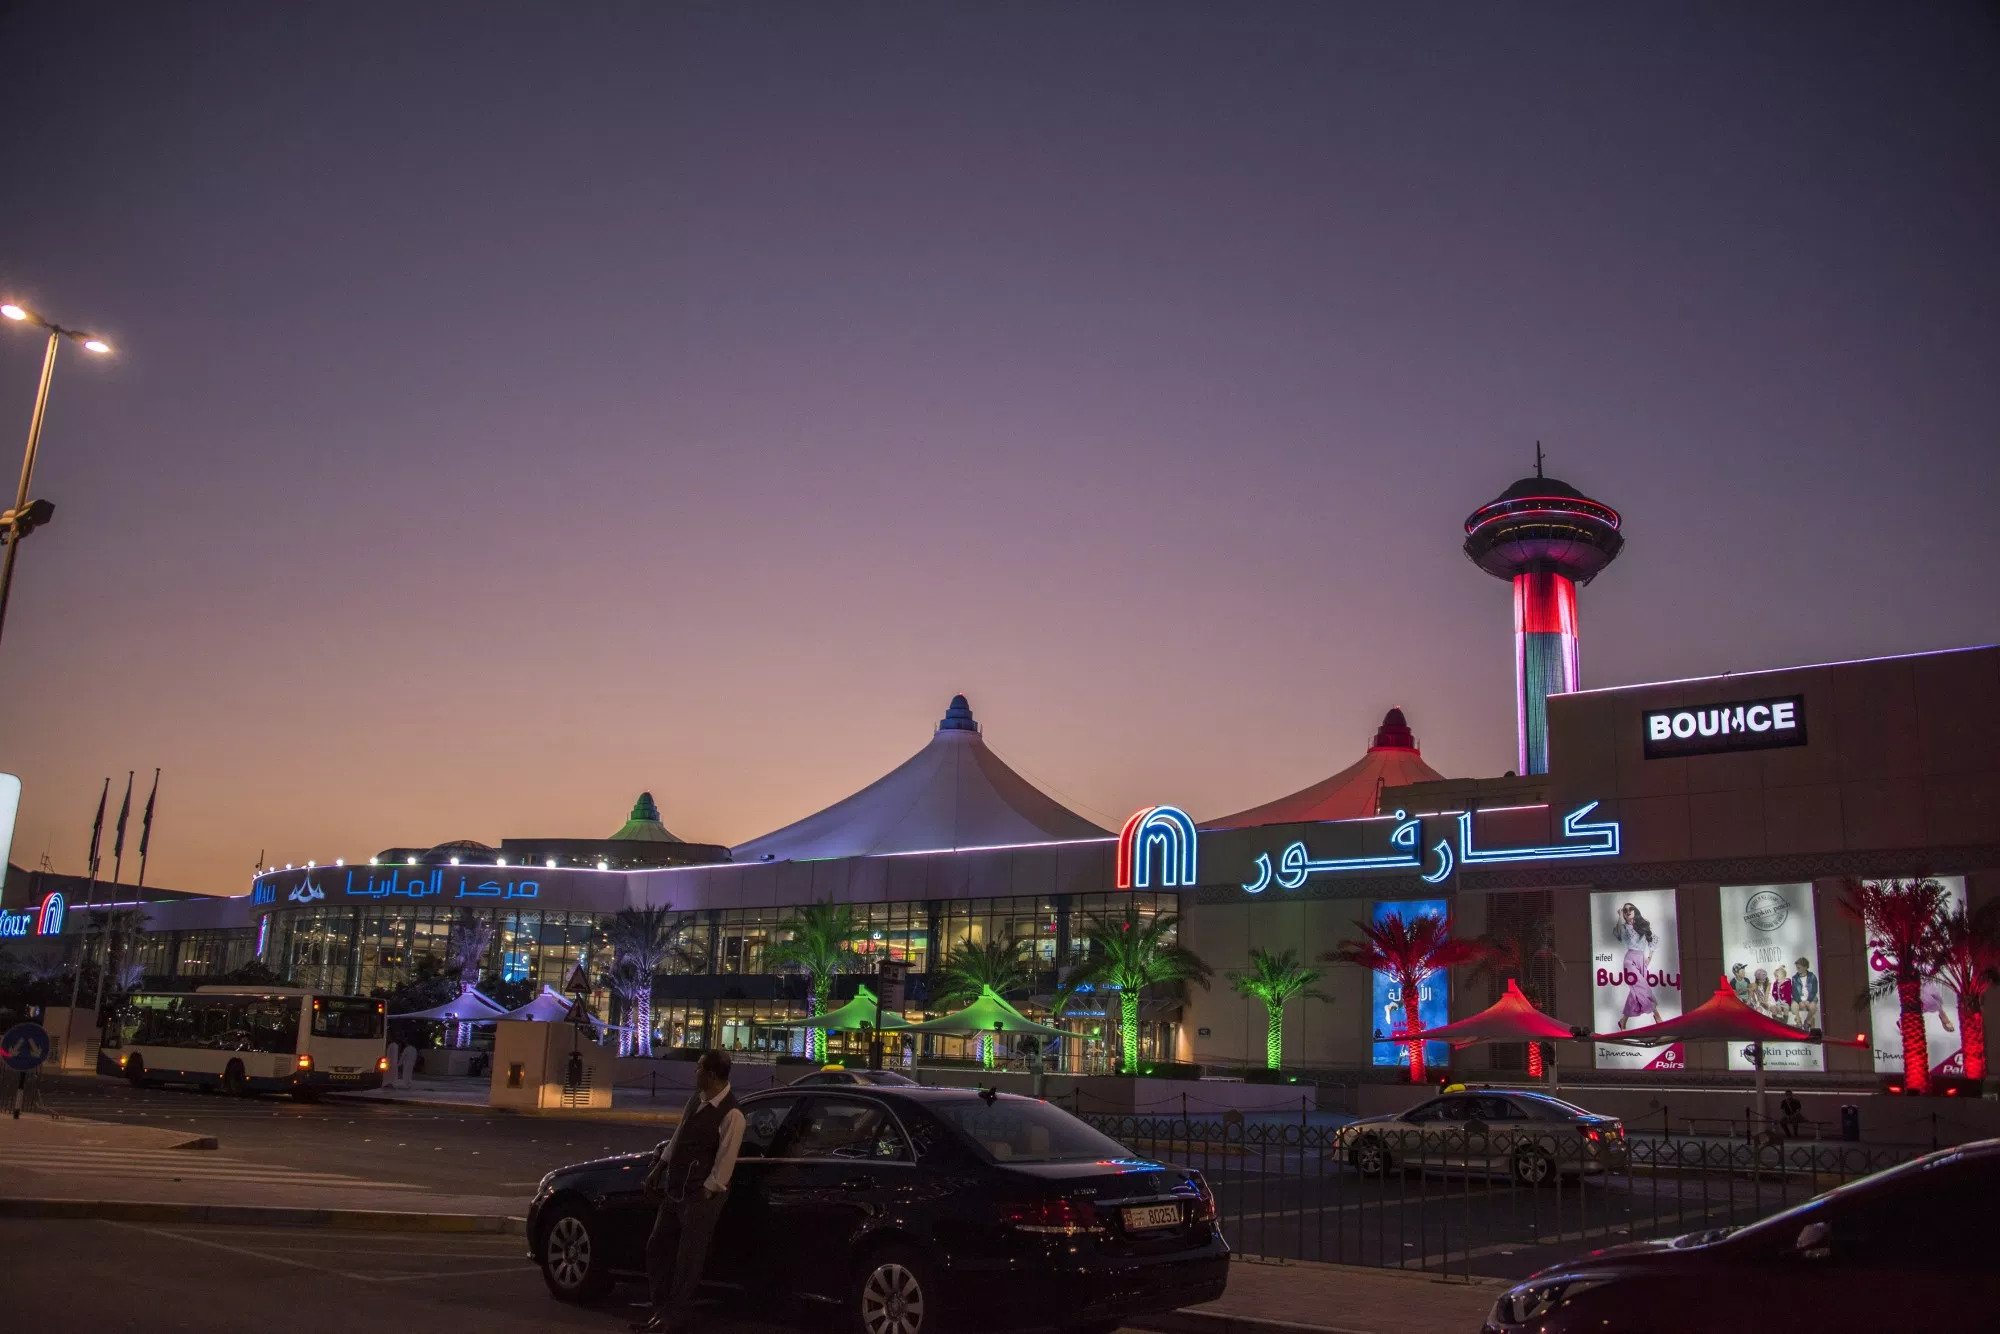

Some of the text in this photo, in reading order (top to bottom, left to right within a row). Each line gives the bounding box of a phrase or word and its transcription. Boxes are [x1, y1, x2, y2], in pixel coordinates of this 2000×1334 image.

[1649, 702, 1796, 741] BOUNCE
[1242, 801, 1619, 893] كارفور
[346, 869, 539, 900] مركز المارينا
[1599, 1047, 1642, 1059] Ipanema
[1740, 1047, 1782, 1057] ppkin
[1655, 1061, 1684, 1069] Pairs
[1149, 1207, 1178, 1224] 80251
